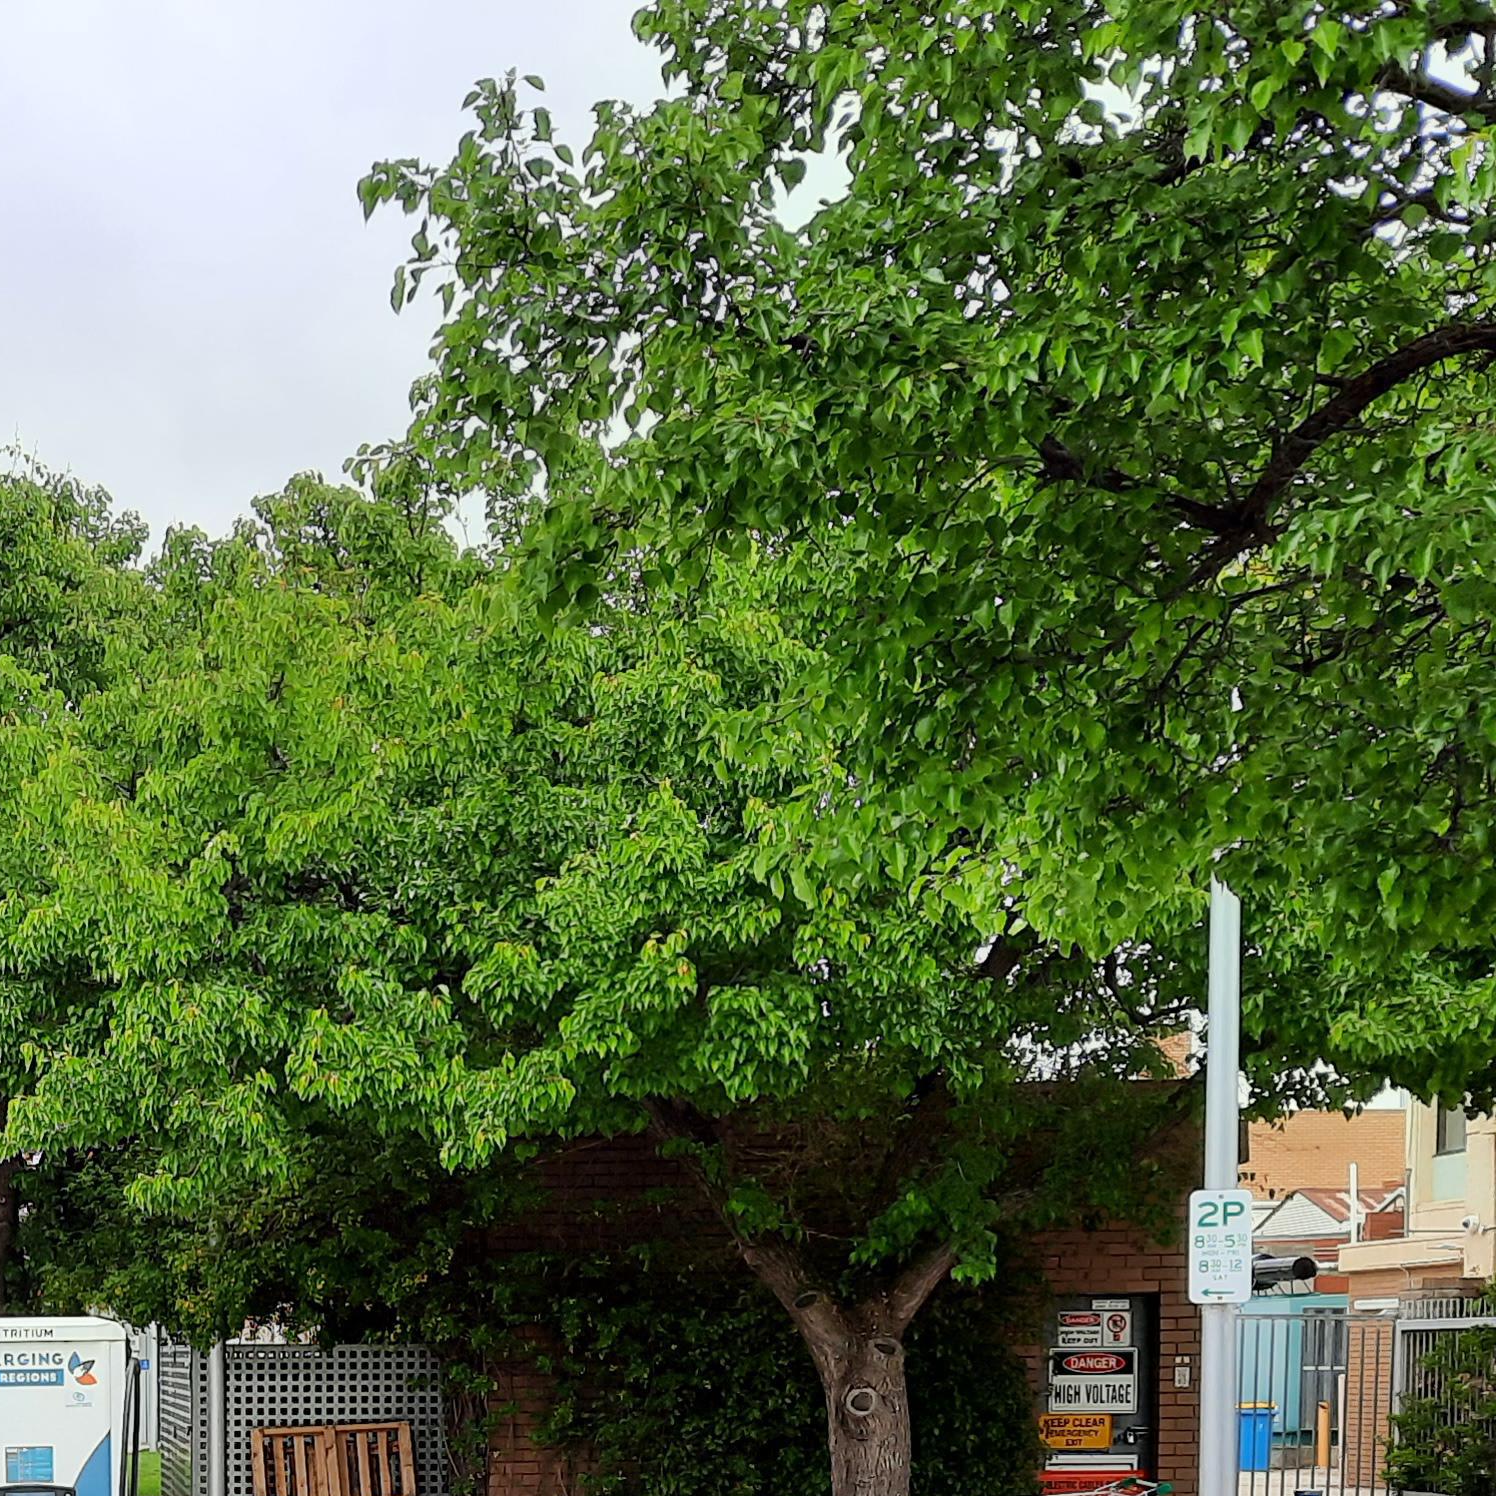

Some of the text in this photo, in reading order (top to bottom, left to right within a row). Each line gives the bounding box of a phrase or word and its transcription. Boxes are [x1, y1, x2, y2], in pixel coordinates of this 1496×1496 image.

[1197, 1201, 1245, 1227] 2P
[3, 1329, 53, 1338] TRITIUM
[1070, 1357, 1117, 1369] DANGER
[0, 1372, 57, 1383] REGIONS
[1054, 1384, 1132, 1404] HIGH VOLTAGE
[1044, 1418, 1105, 1427] KEEP CLEAR
